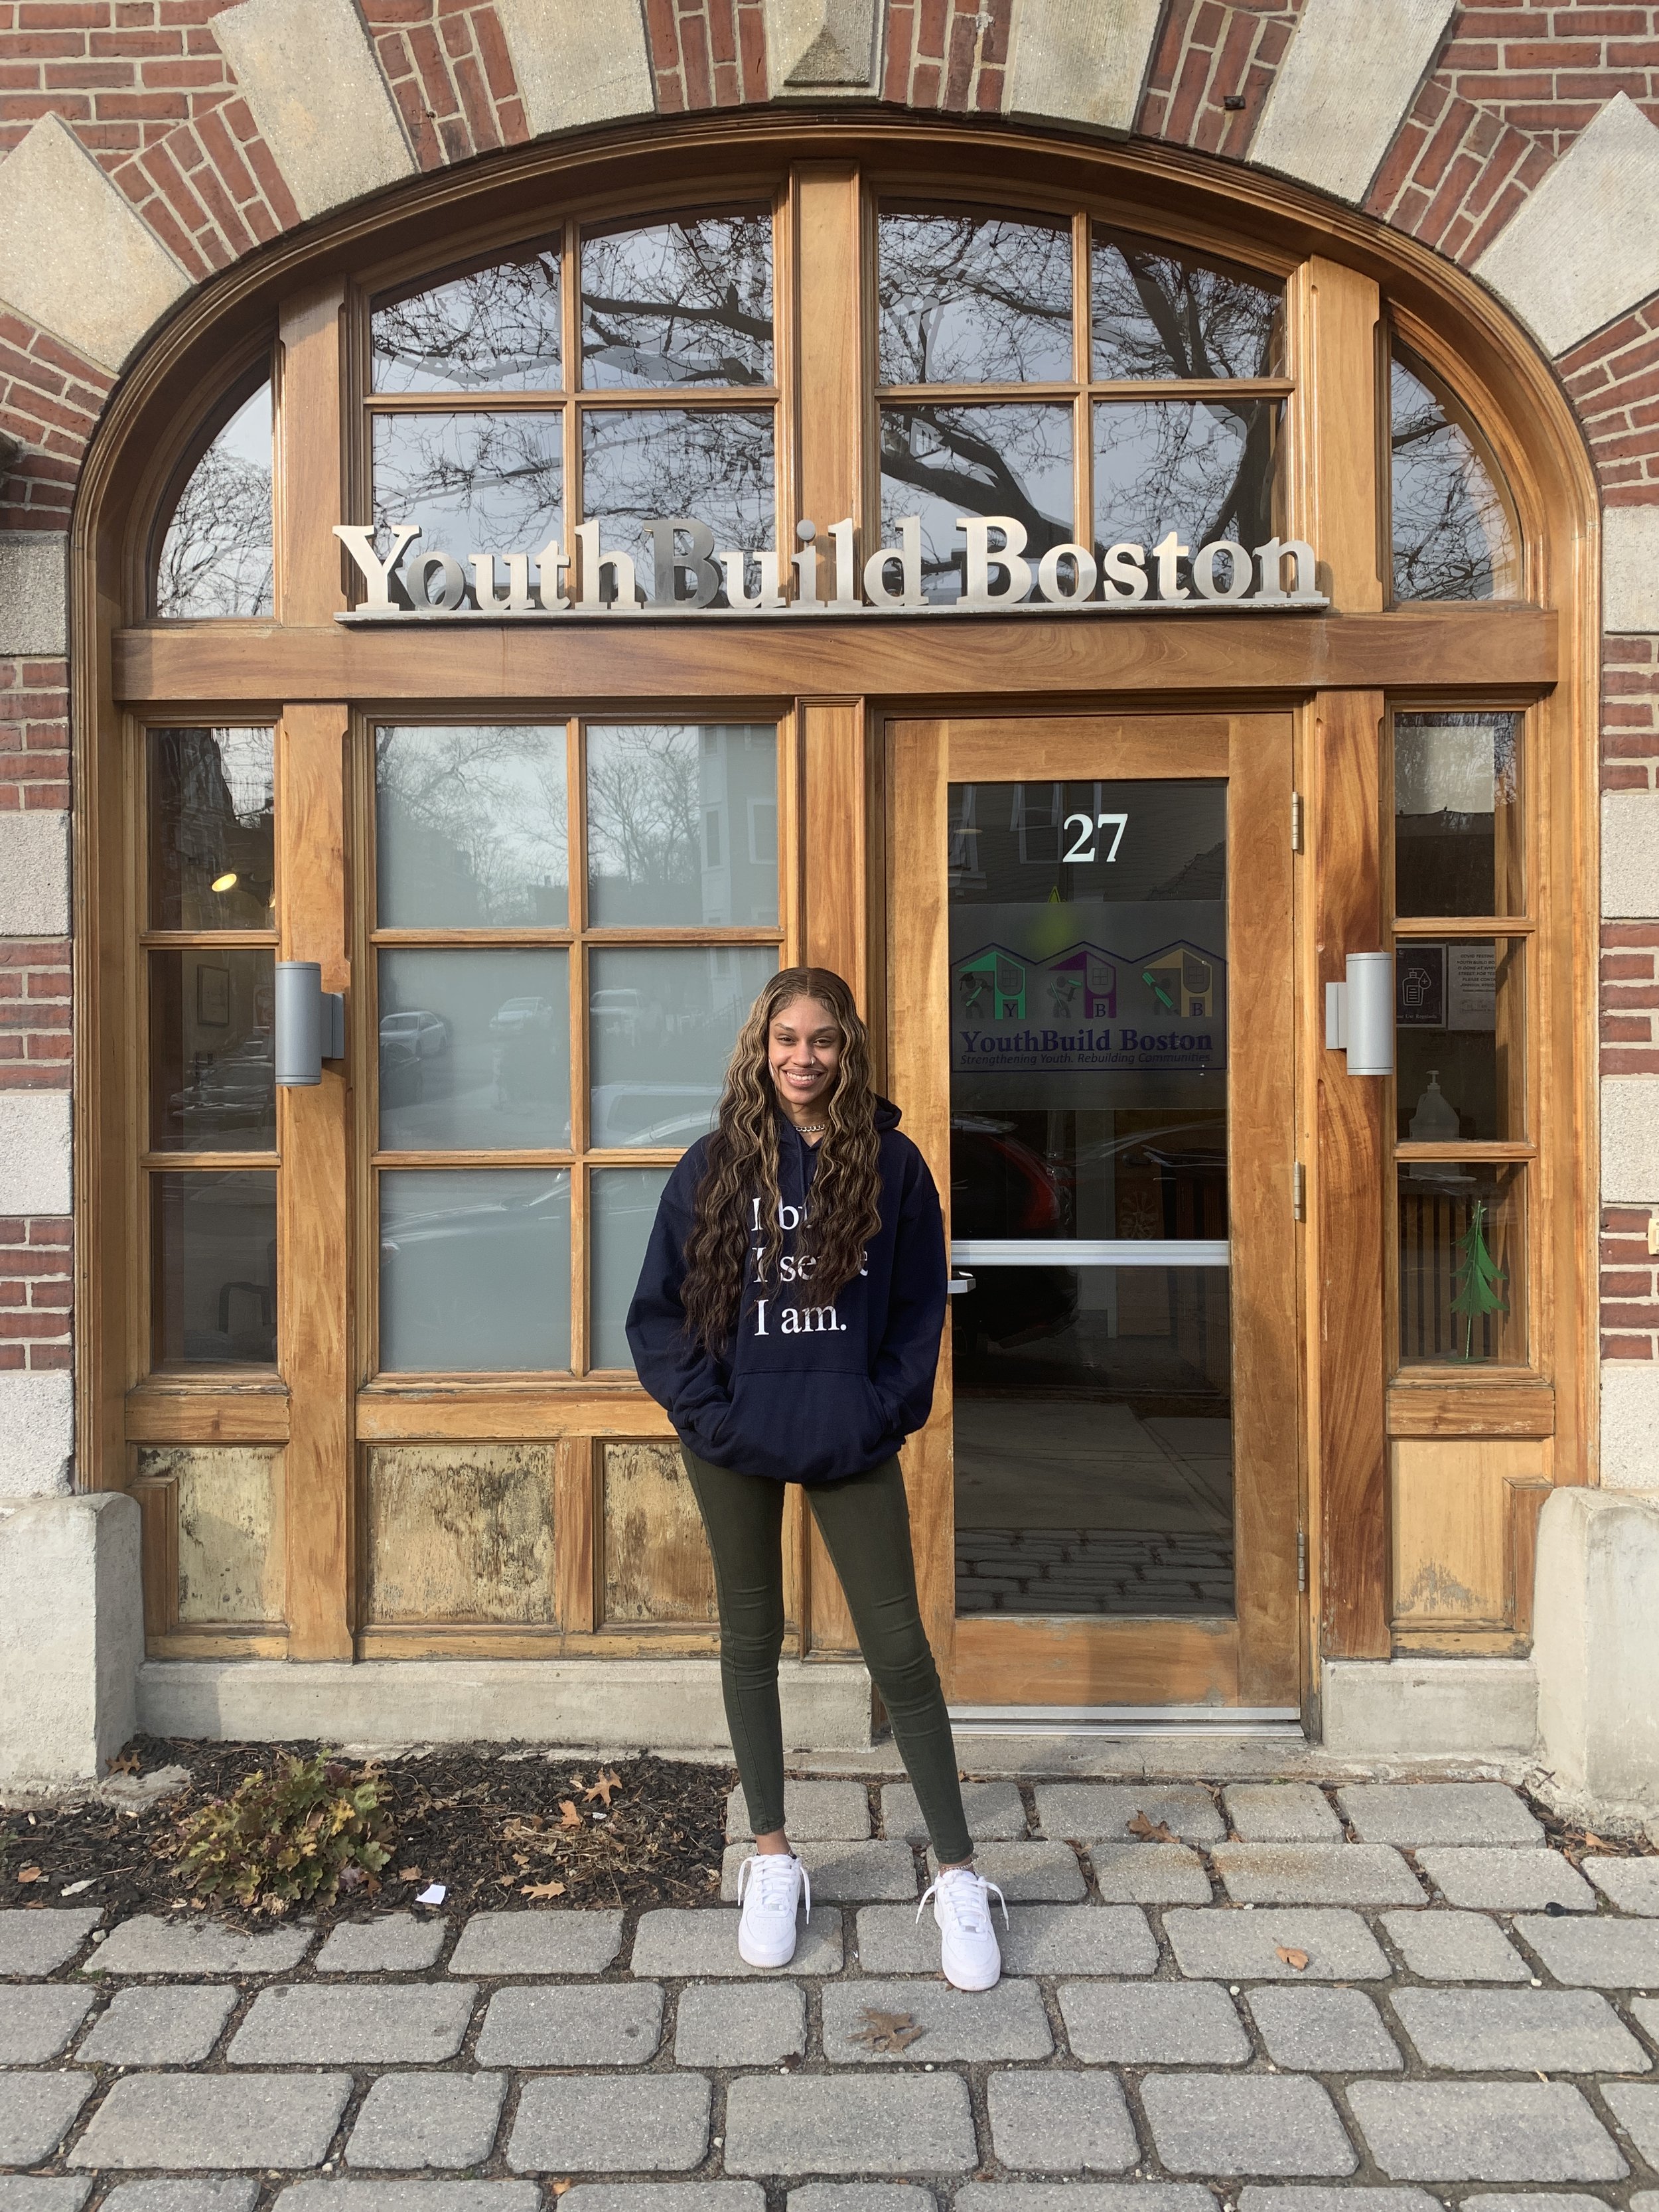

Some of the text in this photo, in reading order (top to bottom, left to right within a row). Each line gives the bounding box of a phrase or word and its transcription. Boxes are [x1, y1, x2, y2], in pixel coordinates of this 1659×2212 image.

[332, 516, 1323, 611] YouthBuild Boston
[1062, 814, 1128, 863] 27
[1004, 1002, 1204, 1017] Y B B
[960, 1029, 1213, 1053] YouthBuild Boston
[960, 1055, 1037, 1066] Strengthening
[1077, 1053, 1135, 1065] Rebuilding
[751, 1197, 764, 1231] I
[752, 1247, 768, 1283] I
[754, 1299, 847, 1336] I am.
